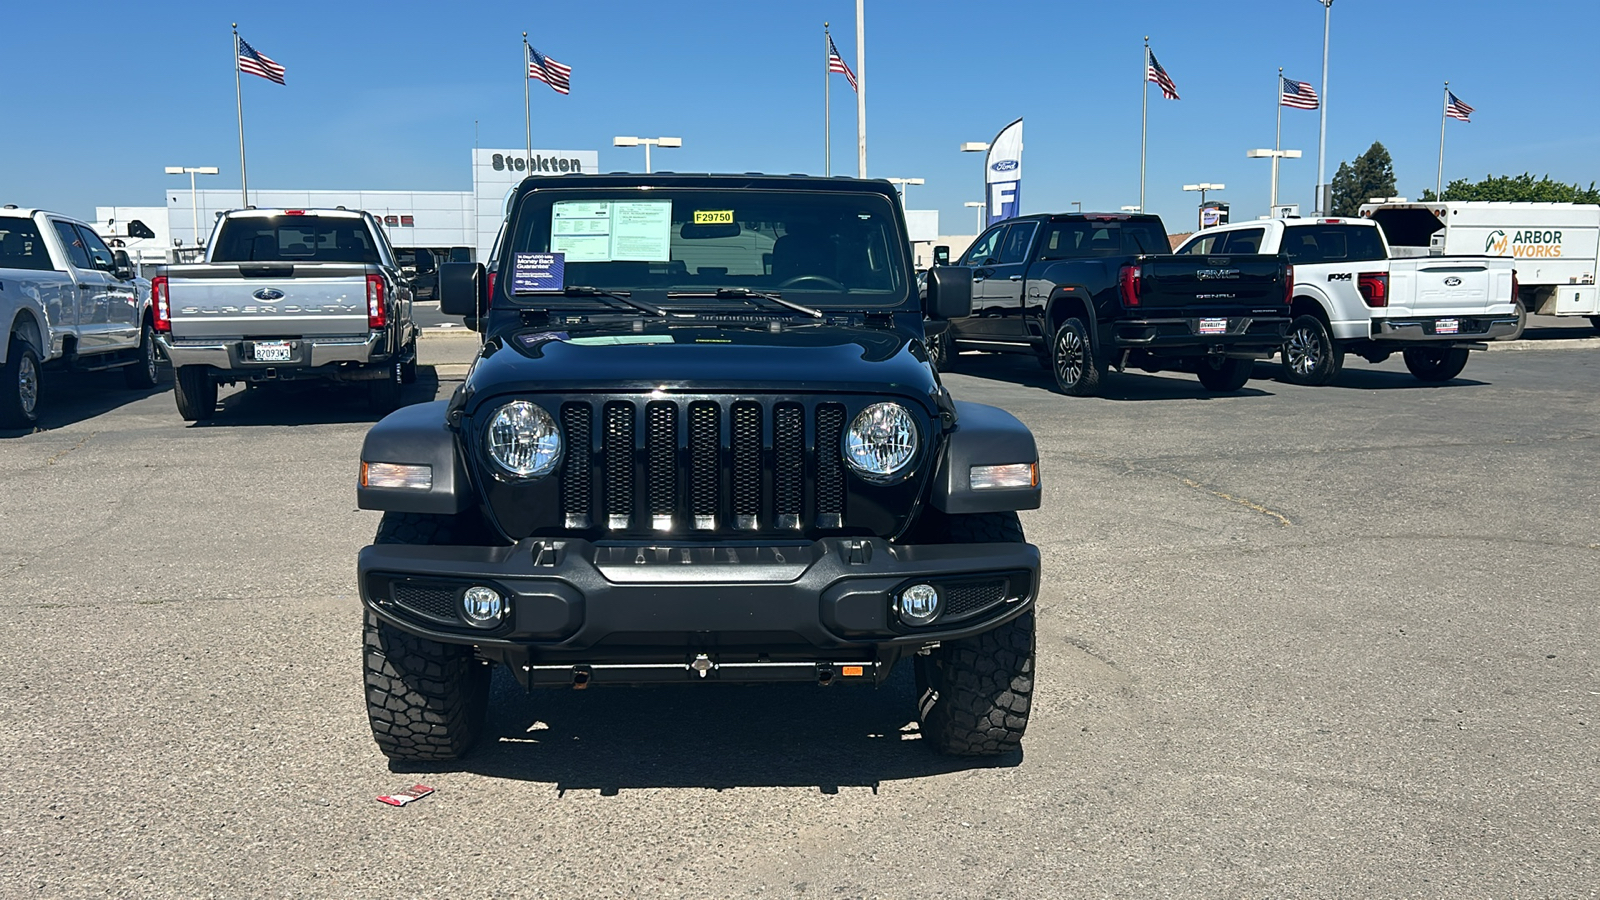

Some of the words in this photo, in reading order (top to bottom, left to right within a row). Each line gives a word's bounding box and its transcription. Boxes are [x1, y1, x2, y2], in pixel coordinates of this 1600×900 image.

[492, 153, 581, 172] Stockton
[996, 161, 1016, 170] Ford
[696, 213, 730, 222] F29750
[1513, 230, 1562, 244] ARBOR
[1513, 245, 1561, 257] WORKS
[1196, 269, 1240, 279] GMC
[1328, 273, 1352, 281] FX4
[181, 306, 277, 314] SUPER
[285, 305, 357, 313] DUTY
